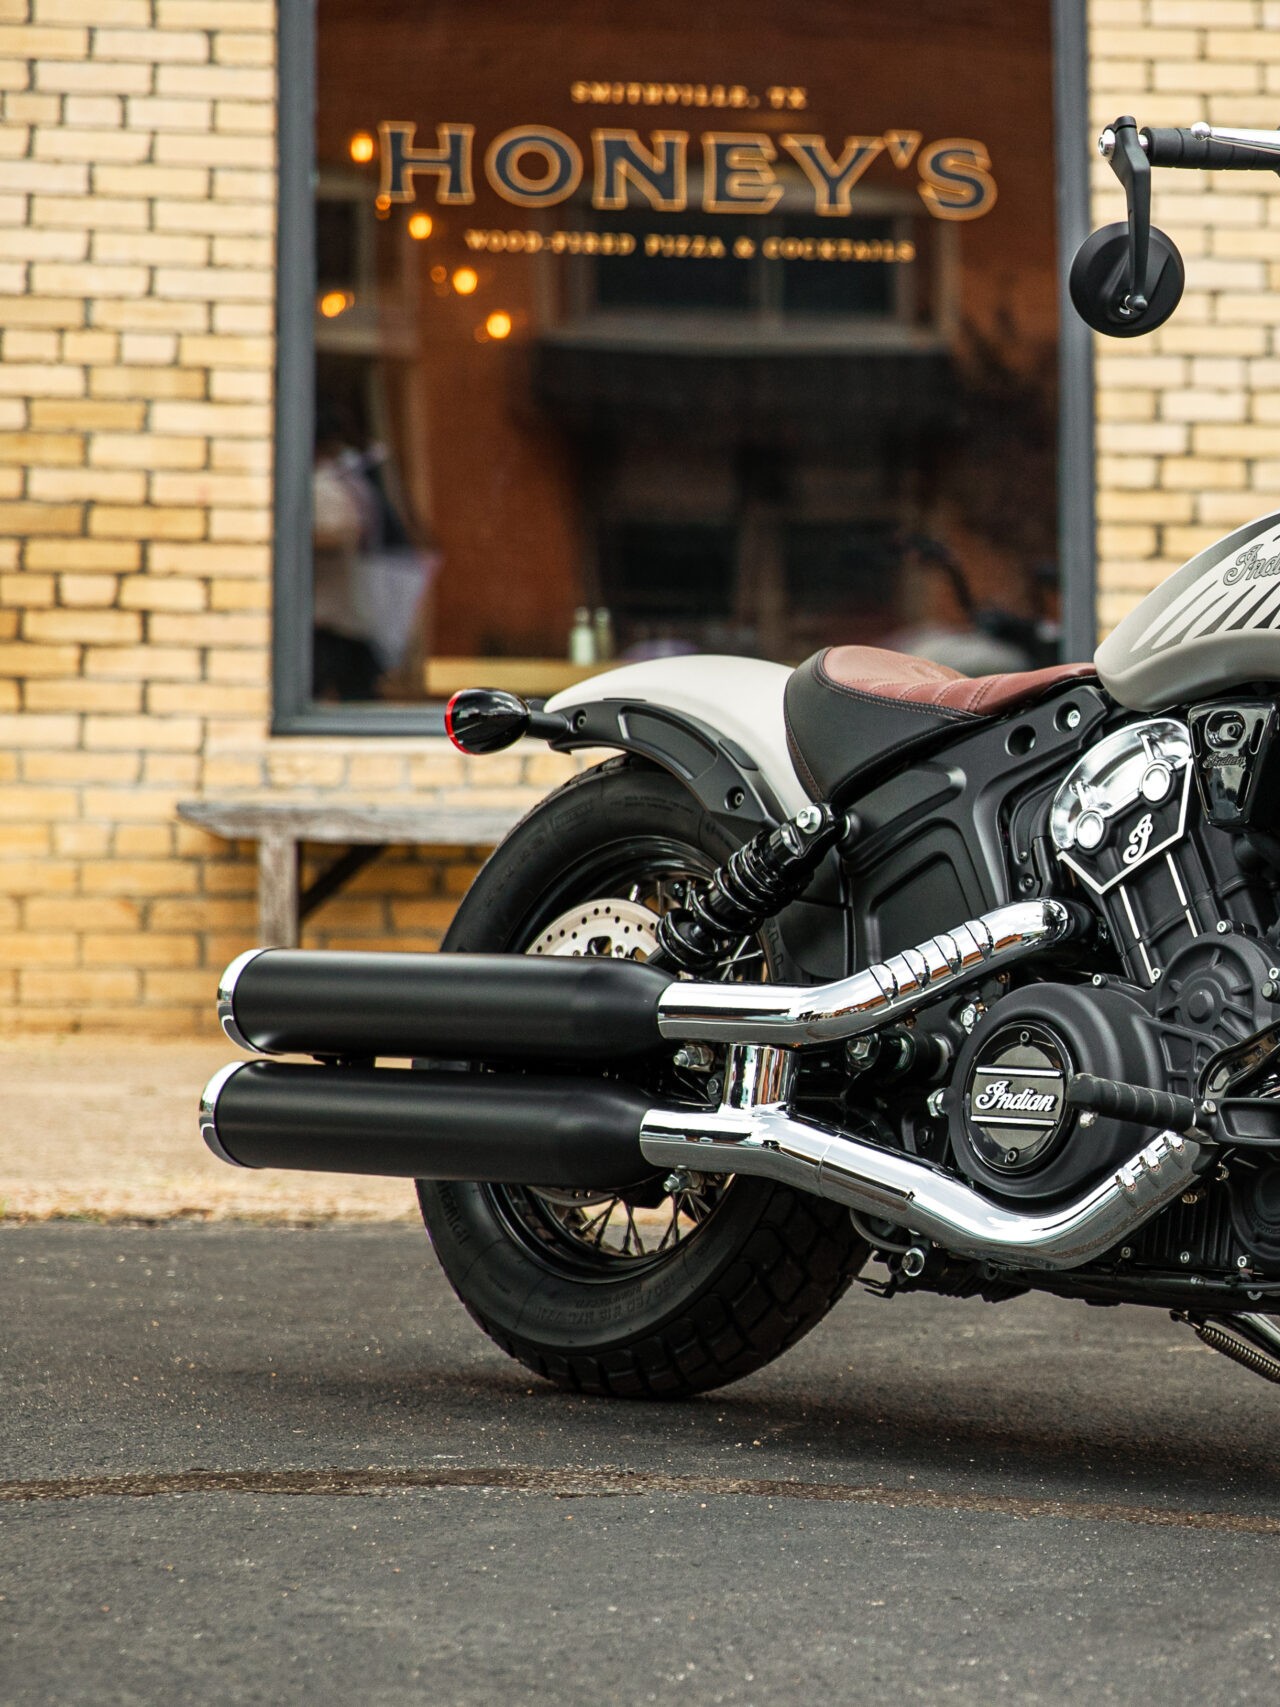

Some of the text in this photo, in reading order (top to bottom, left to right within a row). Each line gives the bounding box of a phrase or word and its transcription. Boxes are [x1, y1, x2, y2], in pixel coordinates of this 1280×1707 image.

[376, 120, 998, 221] HONEY'S
[645, 233, 726, 259] PIZZA
[975, 1080, 1056, 1112] Indian
